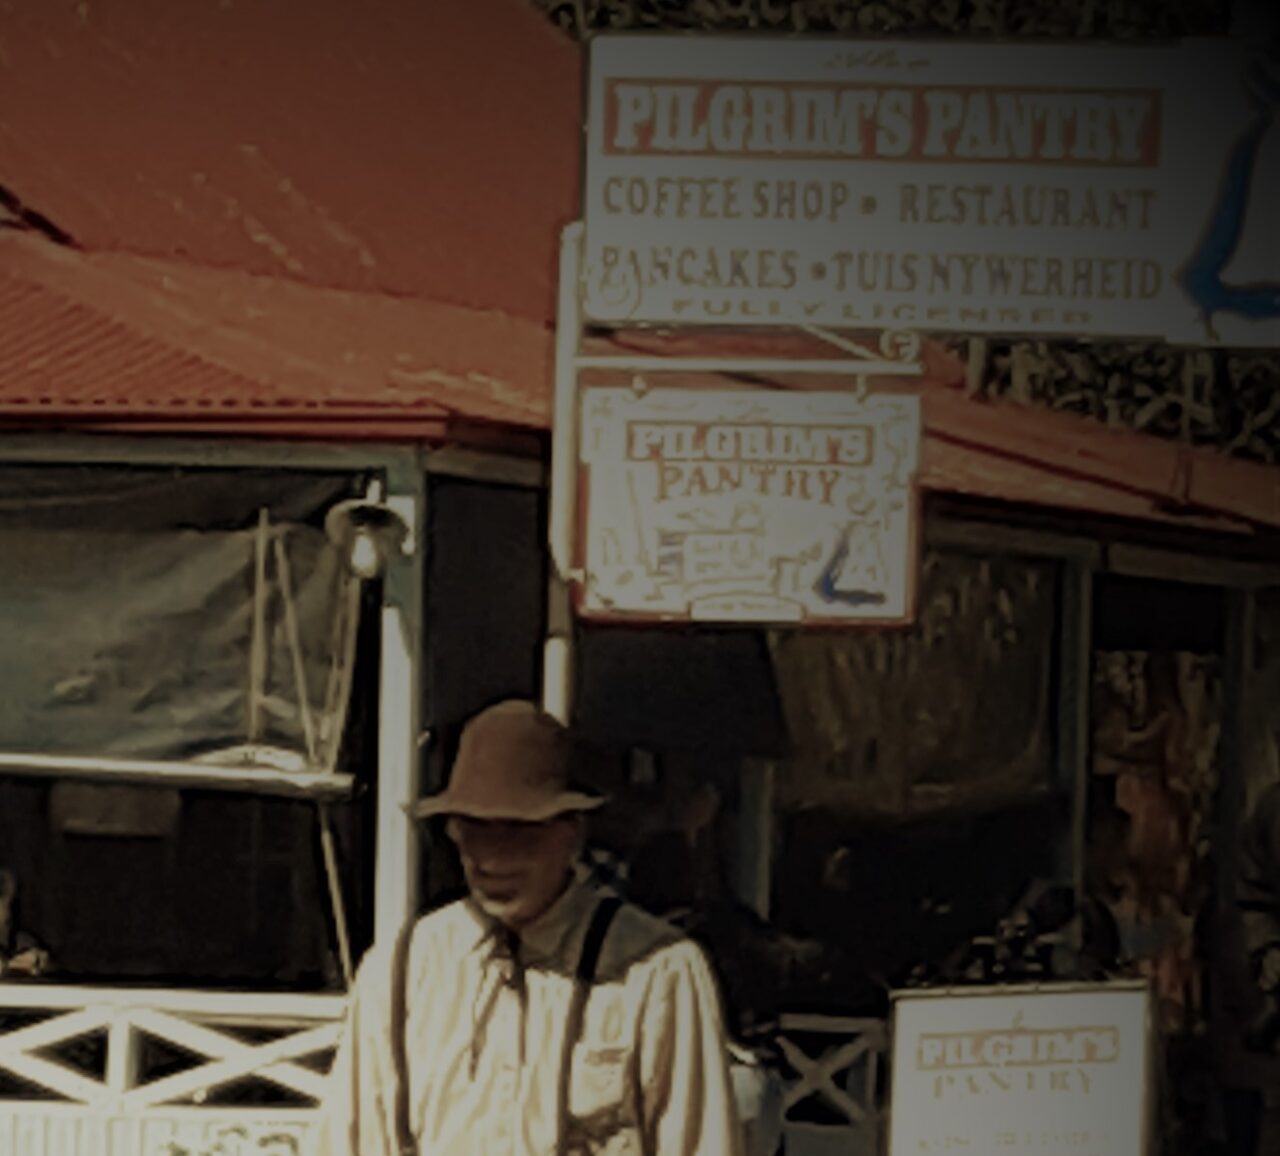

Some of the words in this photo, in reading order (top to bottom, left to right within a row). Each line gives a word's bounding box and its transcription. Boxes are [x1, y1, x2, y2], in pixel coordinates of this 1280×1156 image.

[614, 85, 914, 158] PILGRIM'S
[922, 91, 1152, 161] PANTRY
[603, 176, 743, 218] COFFEE
[752, 179, 850, 224] SHOP
[900, 182, 1157, 230] RESTAURANT
[599, 245, 798, 290] PANCAKES
[634, 426, 867, 464] PILGRIM'S
[656, 464, 839, 505] PANTRY
